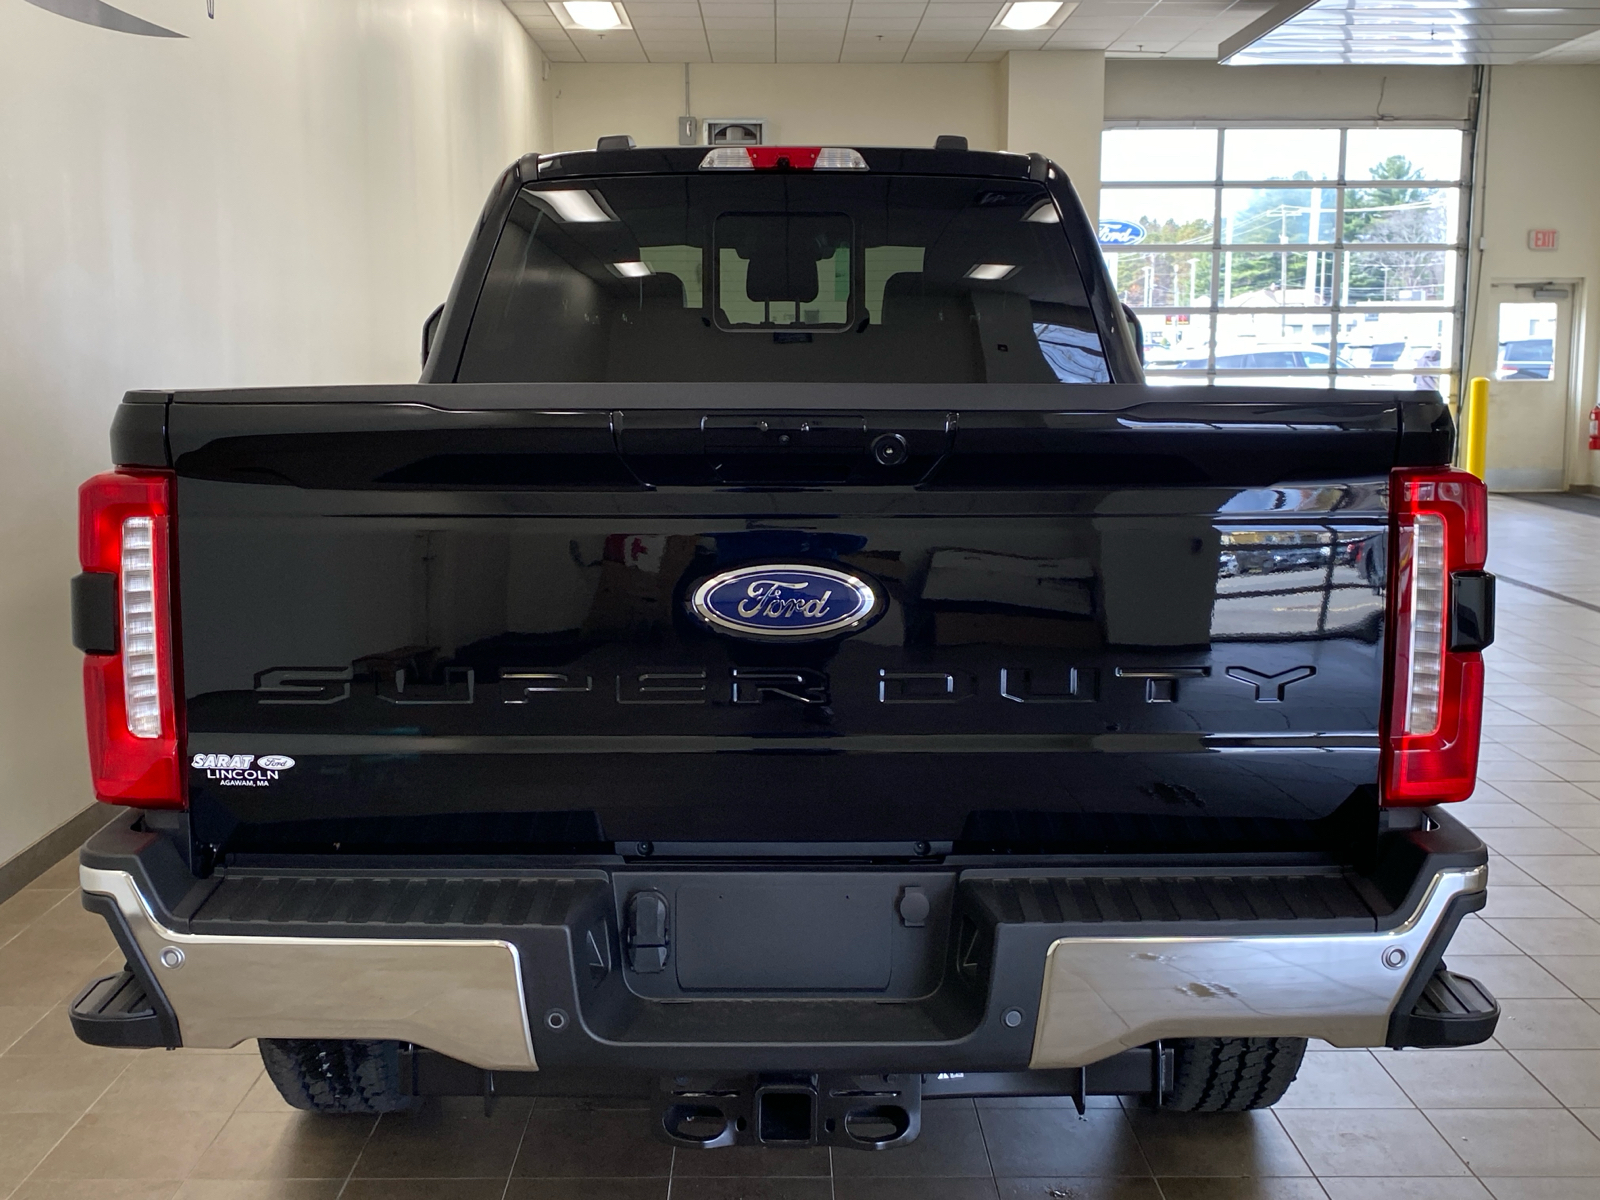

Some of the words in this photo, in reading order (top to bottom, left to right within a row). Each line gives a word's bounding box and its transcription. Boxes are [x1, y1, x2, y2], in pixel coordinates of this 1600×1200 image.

[1534, 229, 1557, 248] EXIT
[737, 580, 832, 618] Ford
[254, 666, 828, 705] SUPER
[879, 665, 1317, 704] DUTY
[191, 753, 255, 769] SARAT
[207, 769, 279, 779] LINCOLN
